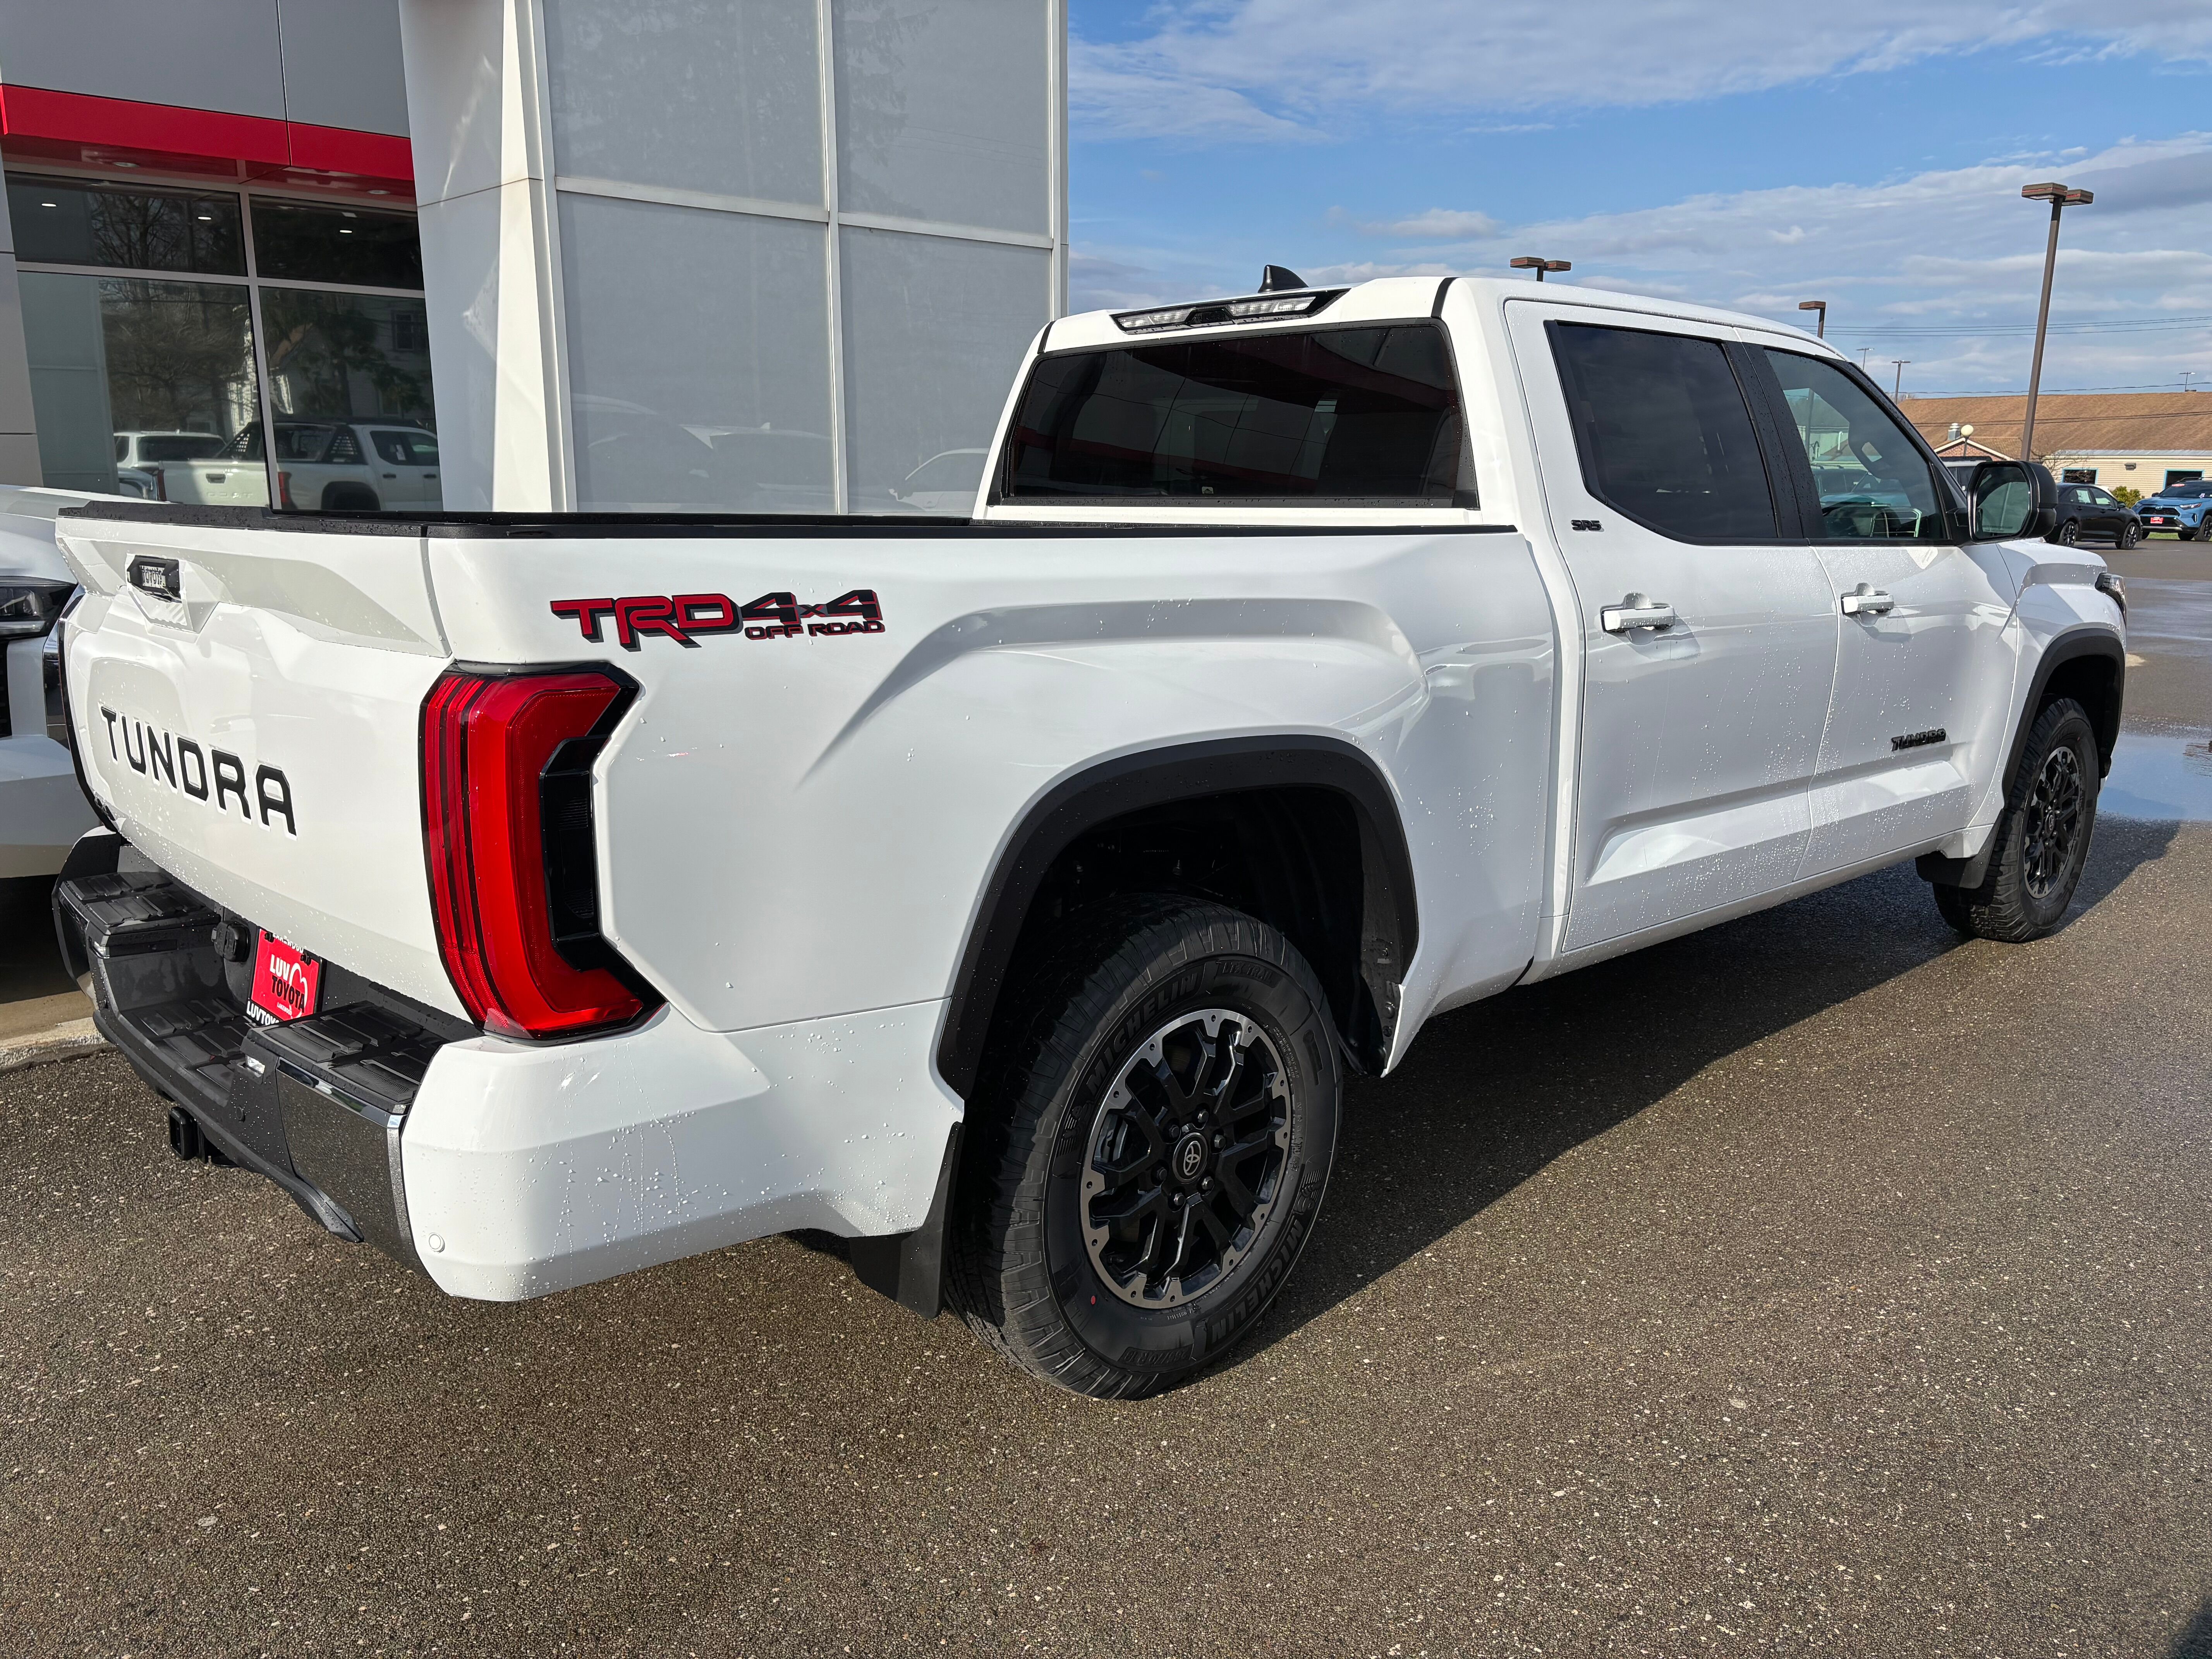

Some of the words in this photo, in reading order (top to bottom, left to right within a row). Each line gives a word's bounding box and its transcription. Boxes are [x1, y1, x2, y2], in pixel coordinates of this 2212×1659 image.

[1571, 520, 1602, 531] SR5
[550, 593, 743, 652] TRD
[745, 624, 804, 640] OFF
[807, 620, 886, 636] ROAD
[1891, 728, 1946, 751] TUNDRA
[100, 705, 297, 838] TUNDRA
[270, 954, 290, 981] LUV
[272, 975, 305, 1013] TOYOTA
[1086, 972, 1198, 1096] MICHELIN
[1211, 1219, 1304, 1344] MICHELIN
